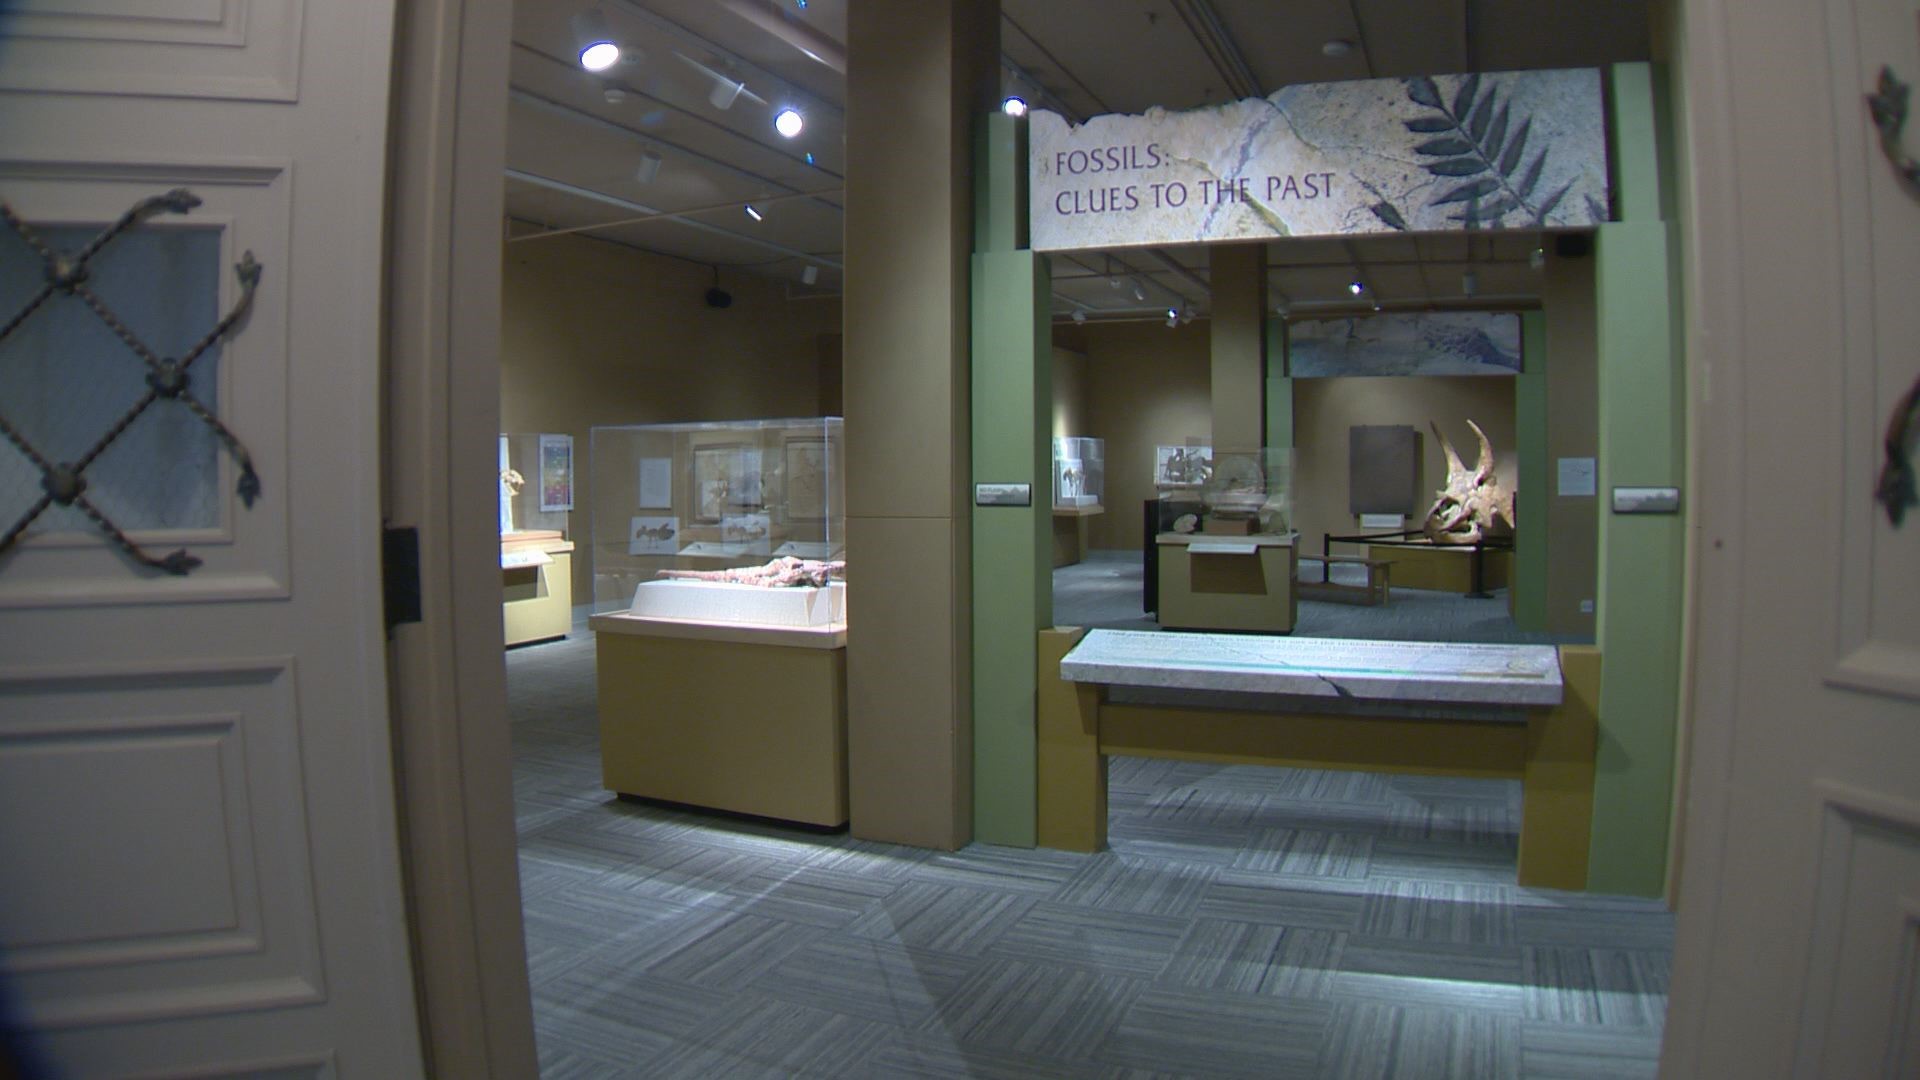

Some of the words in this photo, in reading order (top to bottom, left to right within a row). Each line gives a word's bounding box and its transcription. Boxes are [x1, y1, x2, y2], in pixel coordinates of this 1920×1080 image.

[1055, 143, 1170, 176] FOSSILS:
[1055, 186, 1139, 215] CLUES
[1150, 182, 1188, 208] TO
[1198, 178, 1250, 205] THE
[1267, 172, 1336, 201] PAST
